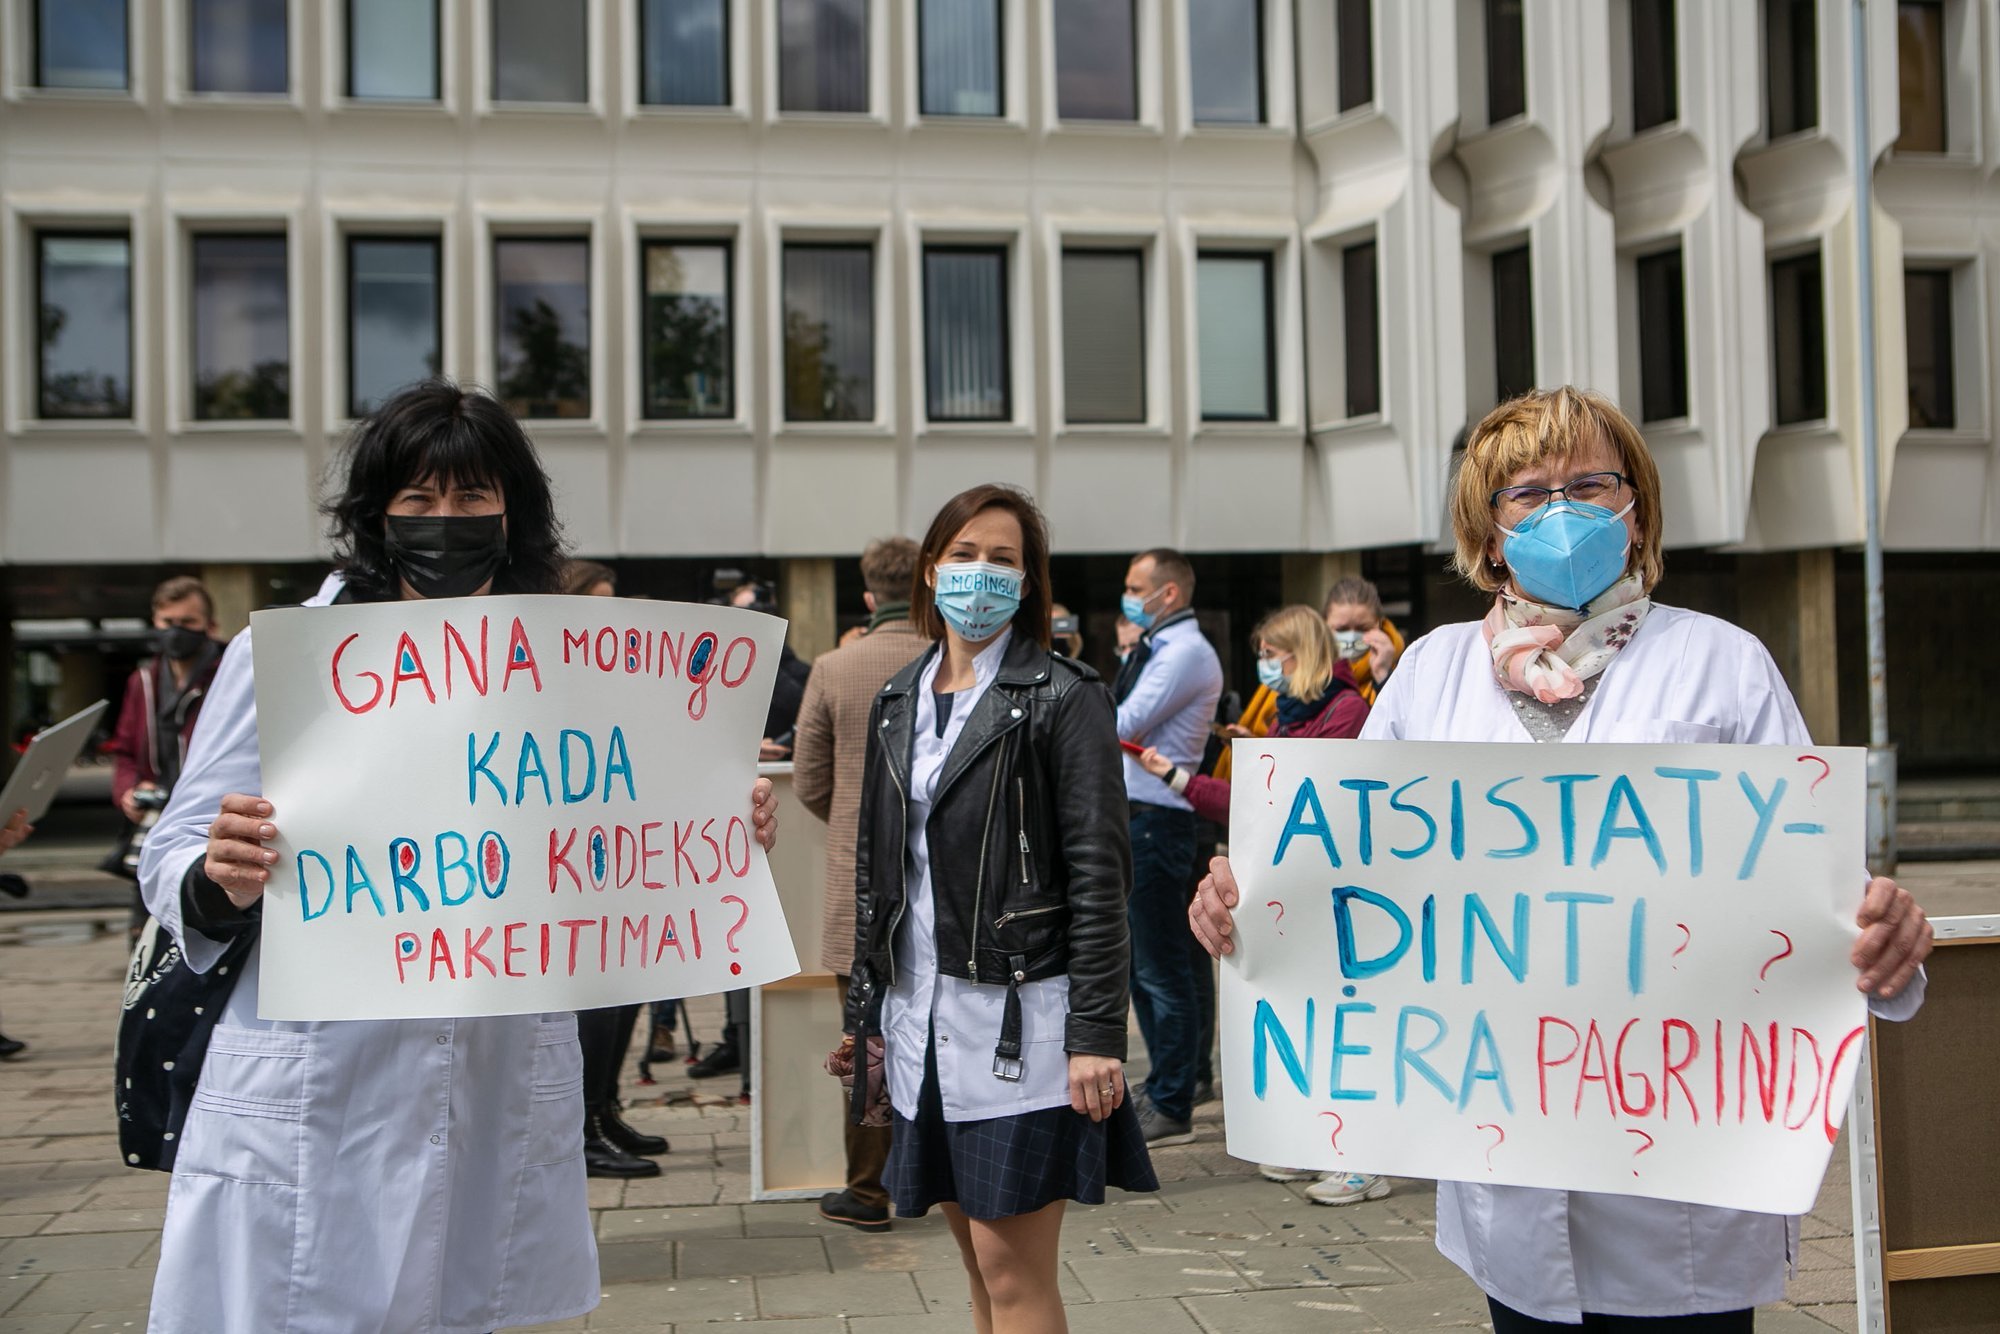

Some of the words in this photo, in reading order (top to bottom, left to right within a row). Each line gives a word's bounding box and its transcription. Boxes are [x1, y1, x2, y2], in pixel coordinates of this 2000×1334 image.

[331, 615, 543, 715] GANA
[467, 725, 637, 807] KADA
[1260, 753, 1276, 806] ?
[1797, 754, 1831, 808] ?
[1272, 765, 1830, 881] ATSISTATY-
[297, 829, 511, 923] DARBO
[548, 815, 752, 895] KODEKSO
[1266, 900, 1285, 937] ?
[1331, 885, 1646, 997] DINTI
[1672, 922, 1692, 971] ?
[1753, 928, 1794, 994] ?
[1252, 984, 1515, 1115] NĖRA
[1317, 1110, 1345, 1156] ?
[1475, 1123, 1506, 1173] ?
[1625, 1128, 1656, 1178] ?
